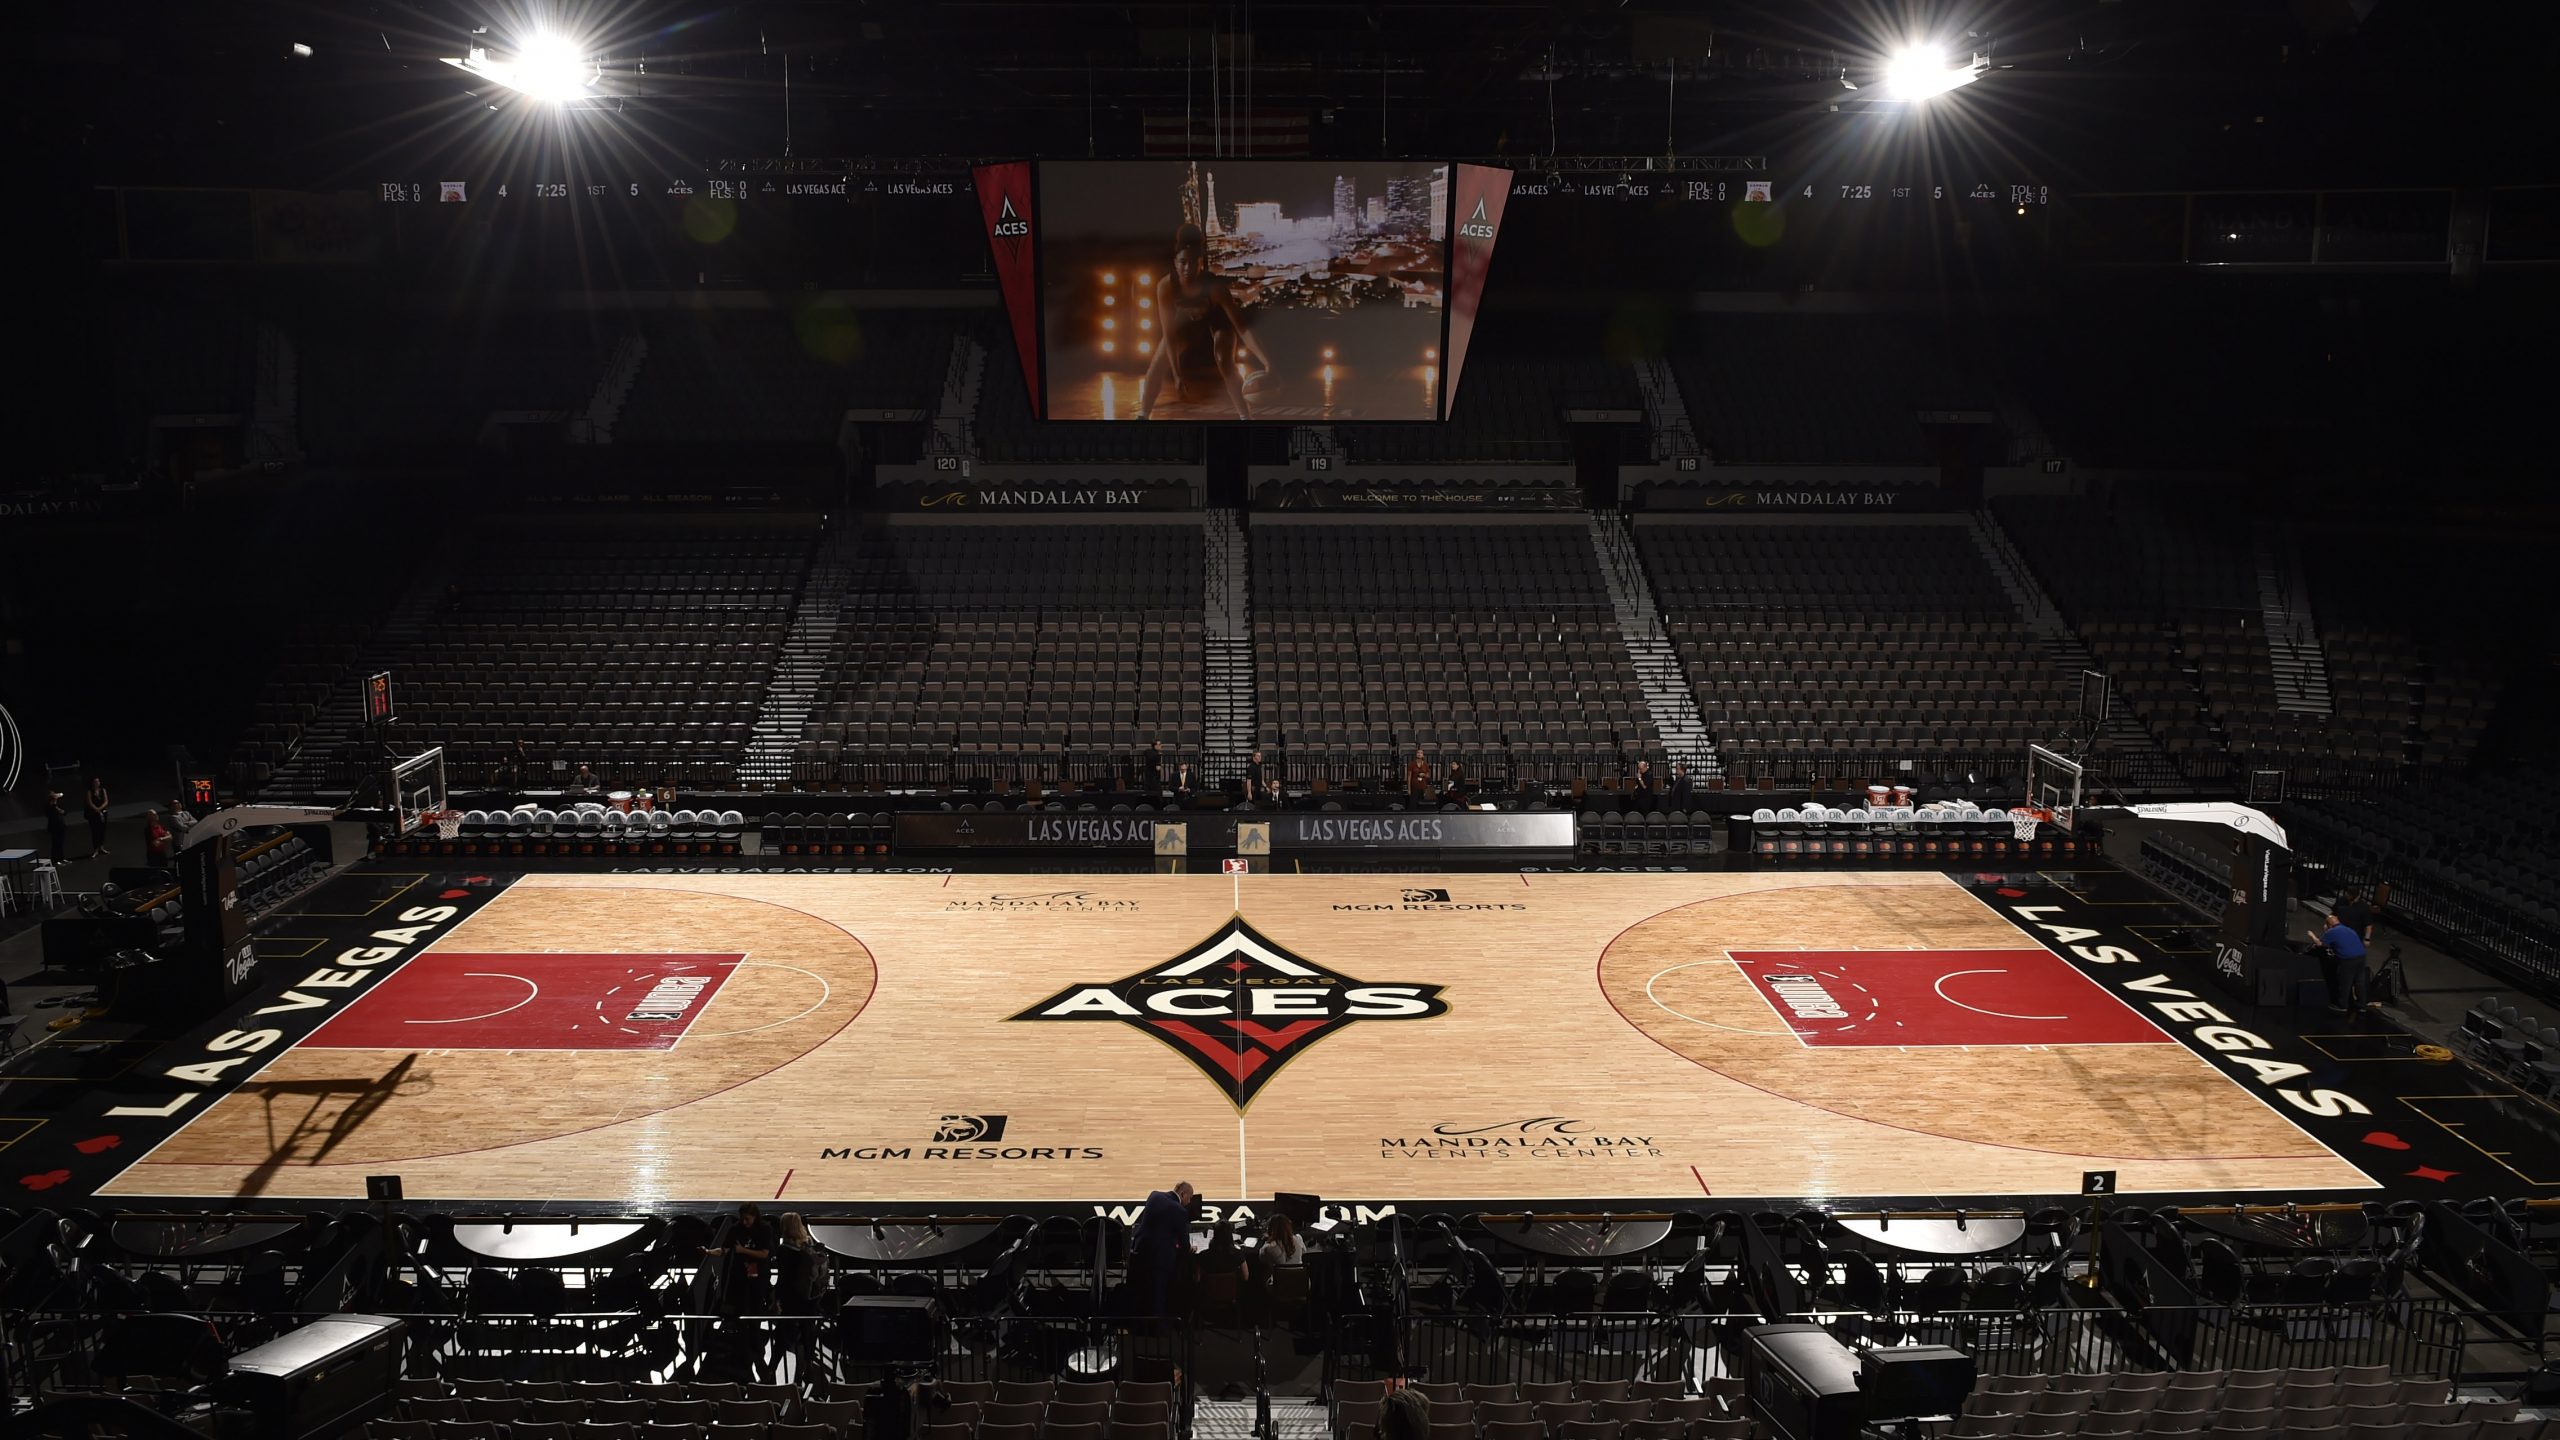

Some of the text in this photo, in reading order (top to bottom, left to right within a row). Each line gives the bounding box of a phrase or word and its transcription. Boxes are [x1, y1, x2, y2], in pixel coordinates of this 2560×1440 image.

[498, 184, 507, 197] 4
[536, 183, 567, 197] 7:25
[588, 186, 606, 195] 1ST
[630, 184, 638, 196] 5
[708, 180, 746, 191] TOL: 0
[786, 184, 802, 195] LAS
[802, 184, 829, 195] VEGAS
[888, 184, 904, 195] LAS
[932, 184, 953, 195] ACES
[1528, 185, 1548, 195] ACES
[1585, 186, 1600, 196] LAS
[1629, 186, 1649, 196] ACES
[1688, 182, 1726, 192] TOL: 0
[740, 189, 747, 199] 0
[1719, 191, 1726, 201] 0
[1803, 185, 1812, 198] 4
[1841, 185, 1871, 198] 7:25
[1891, 188, 1910, 197] 1ST
[1934, 187, 1942, 199] 5
[994, 221, 1028, 237] ACES
[1460, 224, 1494, 238] ACES
[264, 462, 285, 472] 122
[937, 459, 956, 470] 120
[1311, 459, 1327, 470] 119
[1680, 459, 1696, 471] 118
[2046, 461, 2060, 473] 117
[979, 490, 1142, 505] MANDALAY BAY
[1757, 493, 1897, 505] MANDALAY BAY
[663, 790, 671, 800] 6
[703, 813, 715, 822] DR
[1758, 811, 1772, 820] DR
[1781, 811, 1795, 820] DR
[1805, 811, 1818, 820] DR
[1829, 811, 1842, 820] DR
[1852, 811, 1865, 820] DR
[1875, 811, 1888, 820] DR
[1897, 811, 1910, 820] DR
[1920, 811, 1933, 820] DR
[1943, 811, 1956, 820] DR
[1966, 811, 1980, 820] DR
[1989, 811, 2002, 820] DR
[1028, 820, 1062, 841] LAS
[1066, 820, 1125, 841] VEGAS
[1300, 819, 1443, 841] LAS VEGAS ACES
[2216, 943, 2244, 979] Vegas
[226, 951, 259, 985] Vegas
[1040, 987, 1430, 1016] ACES
[101, 904, 460, 1118] LAS VEGAS
[2010, 905, 2374, 1118] LAS VEGAS
[1381, 1136, 1654, 1147] MANDALAY BAY
[820, 1147, 1104, 1160] MGM RESORTS
[1381, 1148, 1665, 1159] EVENTS CENTER
[380, 1181, 389, 1196] 1
[2092, 1175, 2104, 1191] 2
